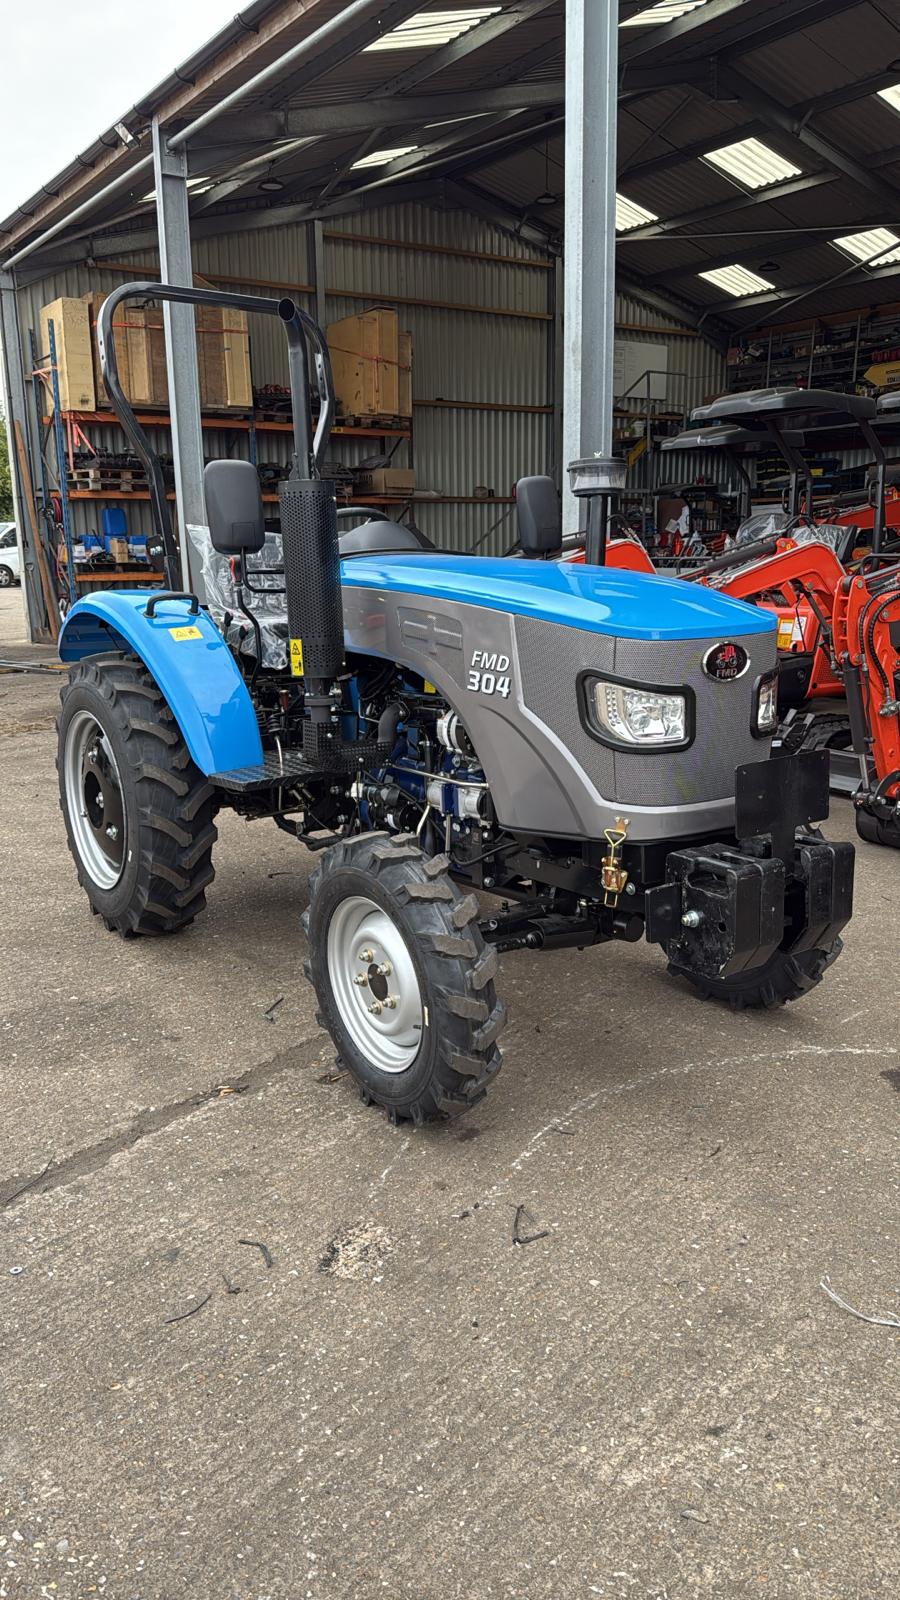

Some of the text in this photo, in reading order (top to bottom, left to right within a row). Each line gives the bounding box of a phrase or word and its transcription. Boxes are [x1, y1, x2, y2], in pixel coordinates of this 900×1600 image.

[471, 651, 510, 672] FMD
[716, 668, 738, 678] FMD
[467, 670, 511, 699] 304
